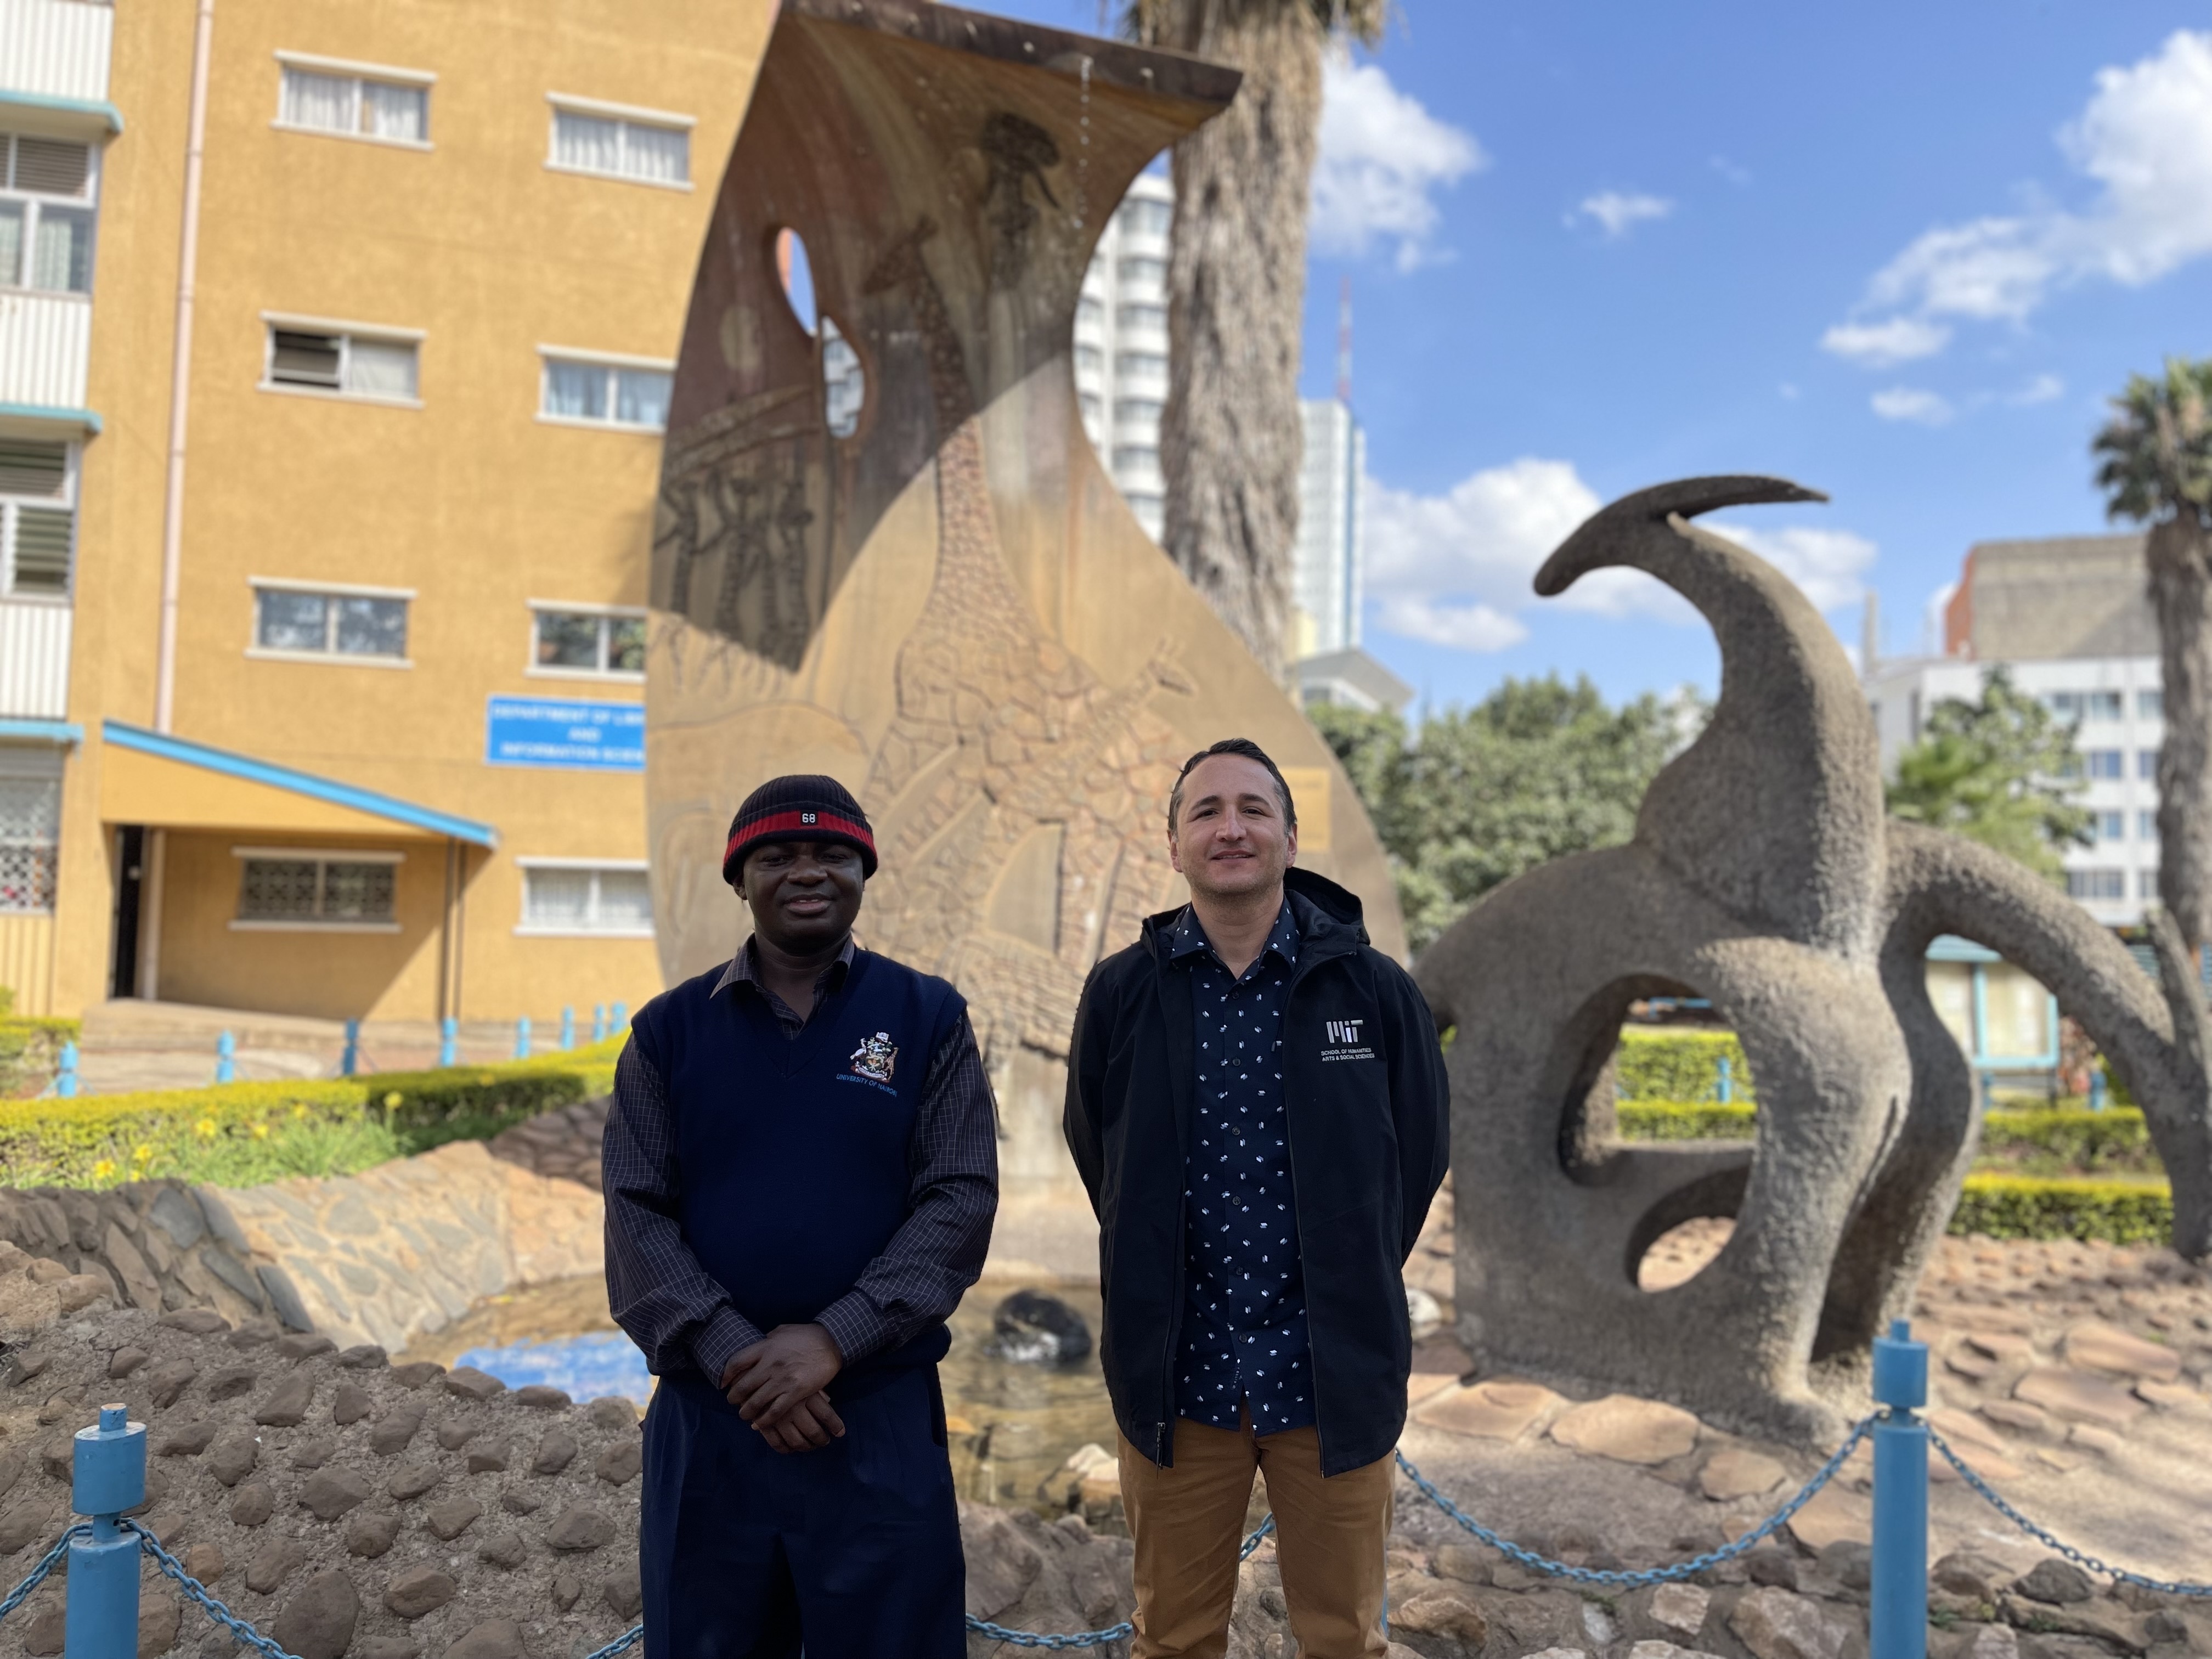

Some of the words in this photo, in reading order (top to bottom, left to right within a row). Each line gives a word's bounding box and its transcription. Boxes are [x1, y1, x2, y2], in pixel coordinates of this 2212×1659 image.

[492, 705, 588, 721] DEPARTMENT
[592, 711, 609, 723] OF
[569, 728, 601, 741] AND
[501, 742, 599, 759] INFORMATION
[802, 813, 816, 823] 68
[1326, 1019, 1363, 1043] MIT
[836, 1073, 868, 1085] UNIVERSITY
